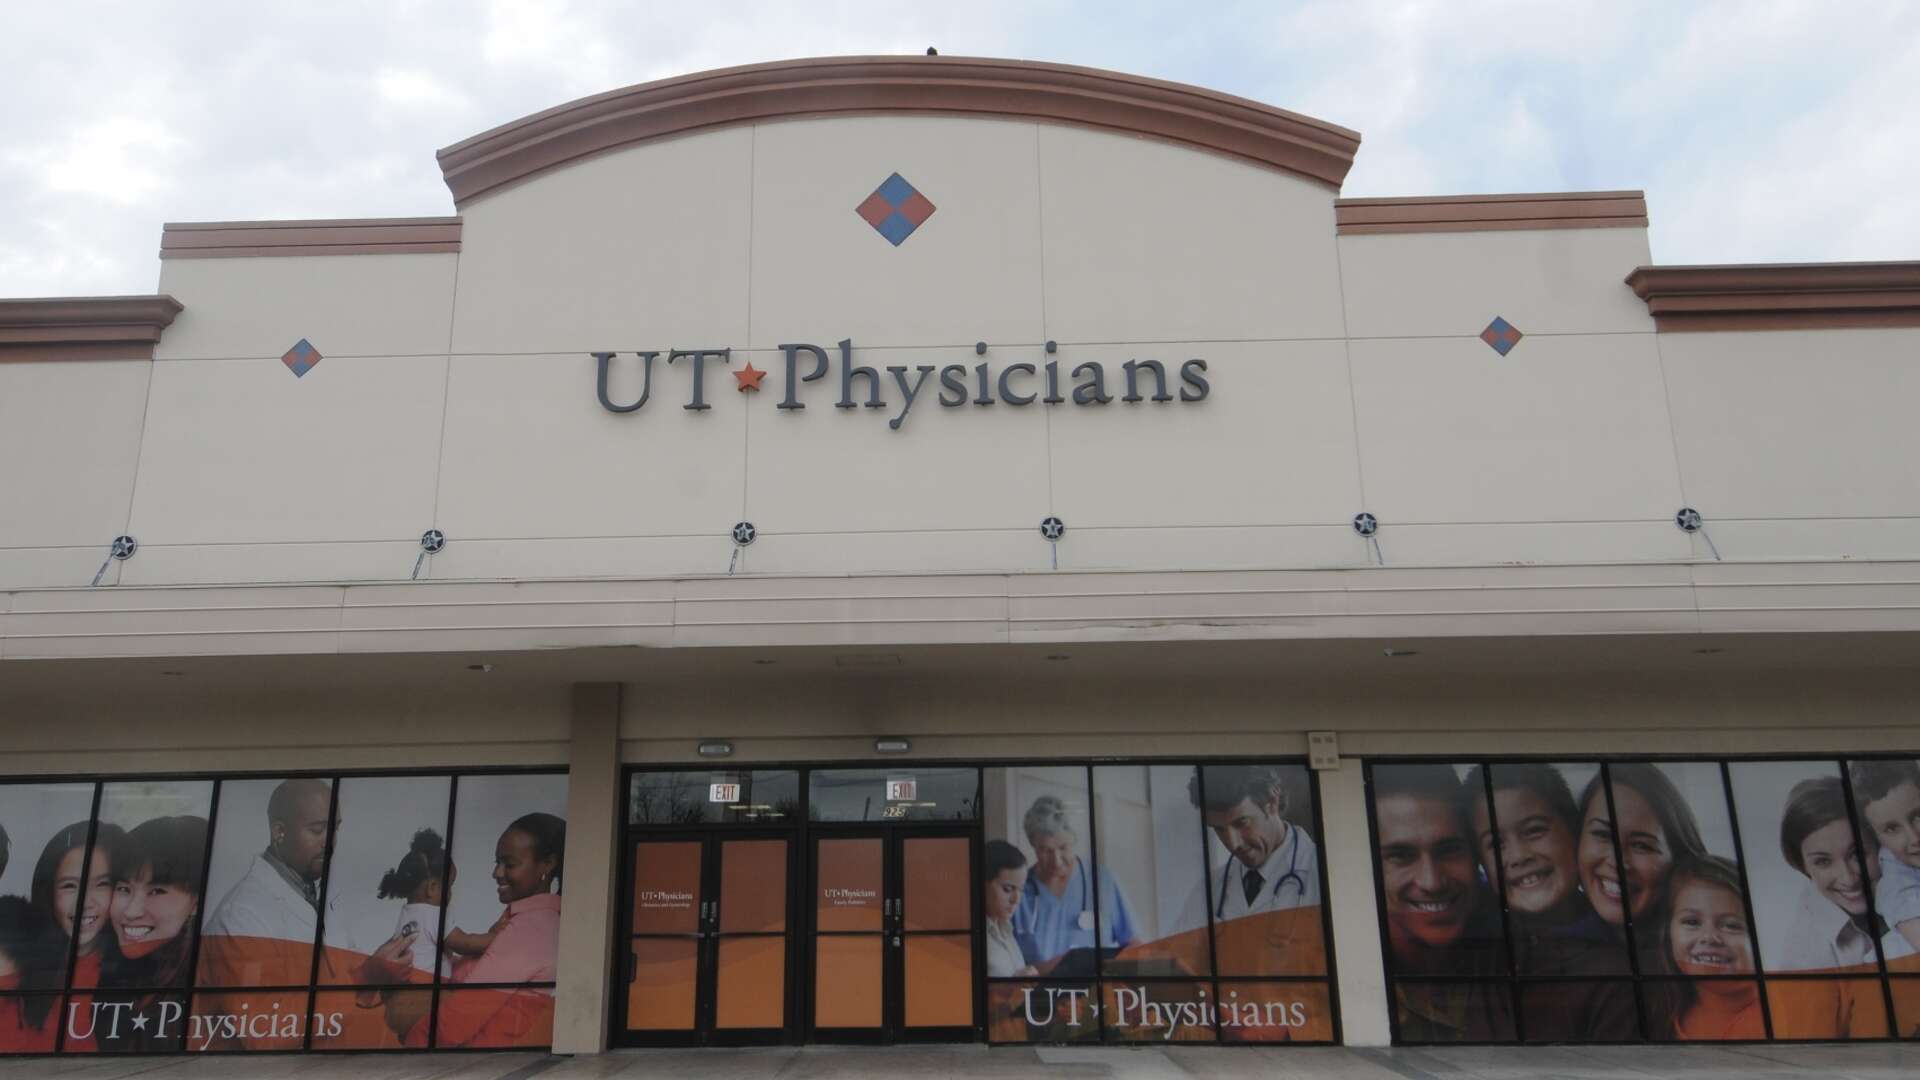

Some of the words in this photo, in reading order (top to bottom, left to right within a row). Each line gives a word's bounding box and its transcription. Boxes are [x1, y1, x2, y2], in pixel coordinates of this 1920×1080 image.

[591, 347, 731, 413] UT
[777, 339, 1212, 431] Physicians
[715, 785, 737, 801] EXIT
[892, 783, 913, 799] EXIT
[641, 891, 655, 901] UT
[824, 888, 839, 898] UT
[67, 1000, 134, 1040] UT
[1021, 986, 1089, 1026] UT
[1113, 986, 1307, 1040] Physicians
